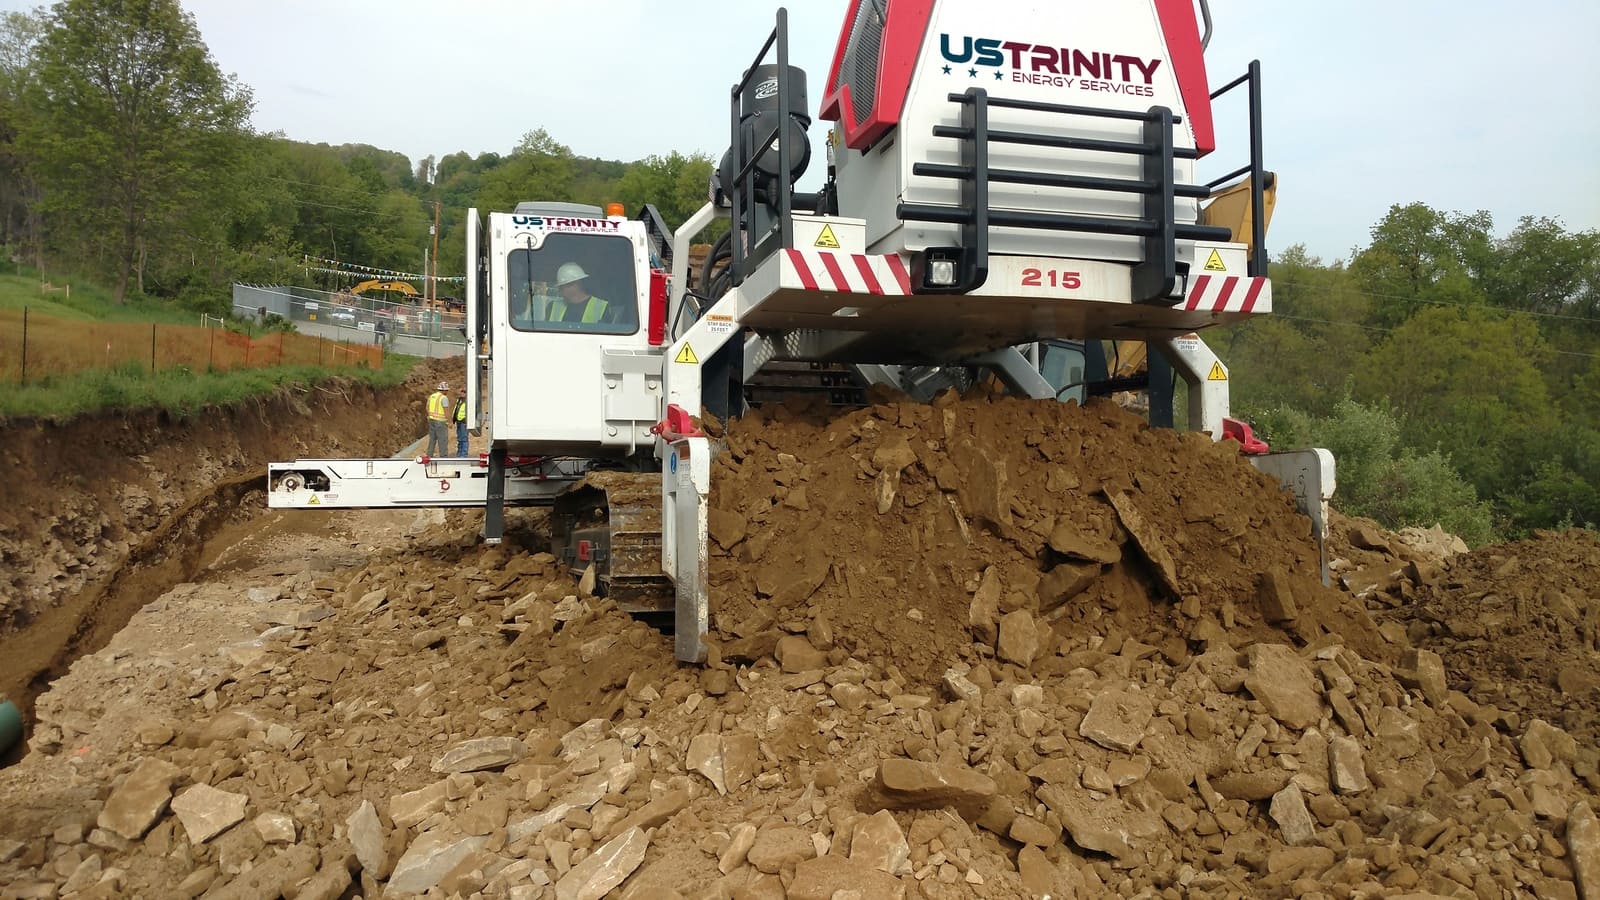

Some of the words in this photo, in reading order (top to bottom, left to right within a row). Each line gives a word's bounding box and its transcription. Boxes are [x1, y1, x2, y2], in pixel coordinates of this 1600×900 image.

[1012, 72, 1074, 88] ENERGY
[1079, 79, 1154, 97] SERVICES
[1021, 268, 1081, 289] 215
